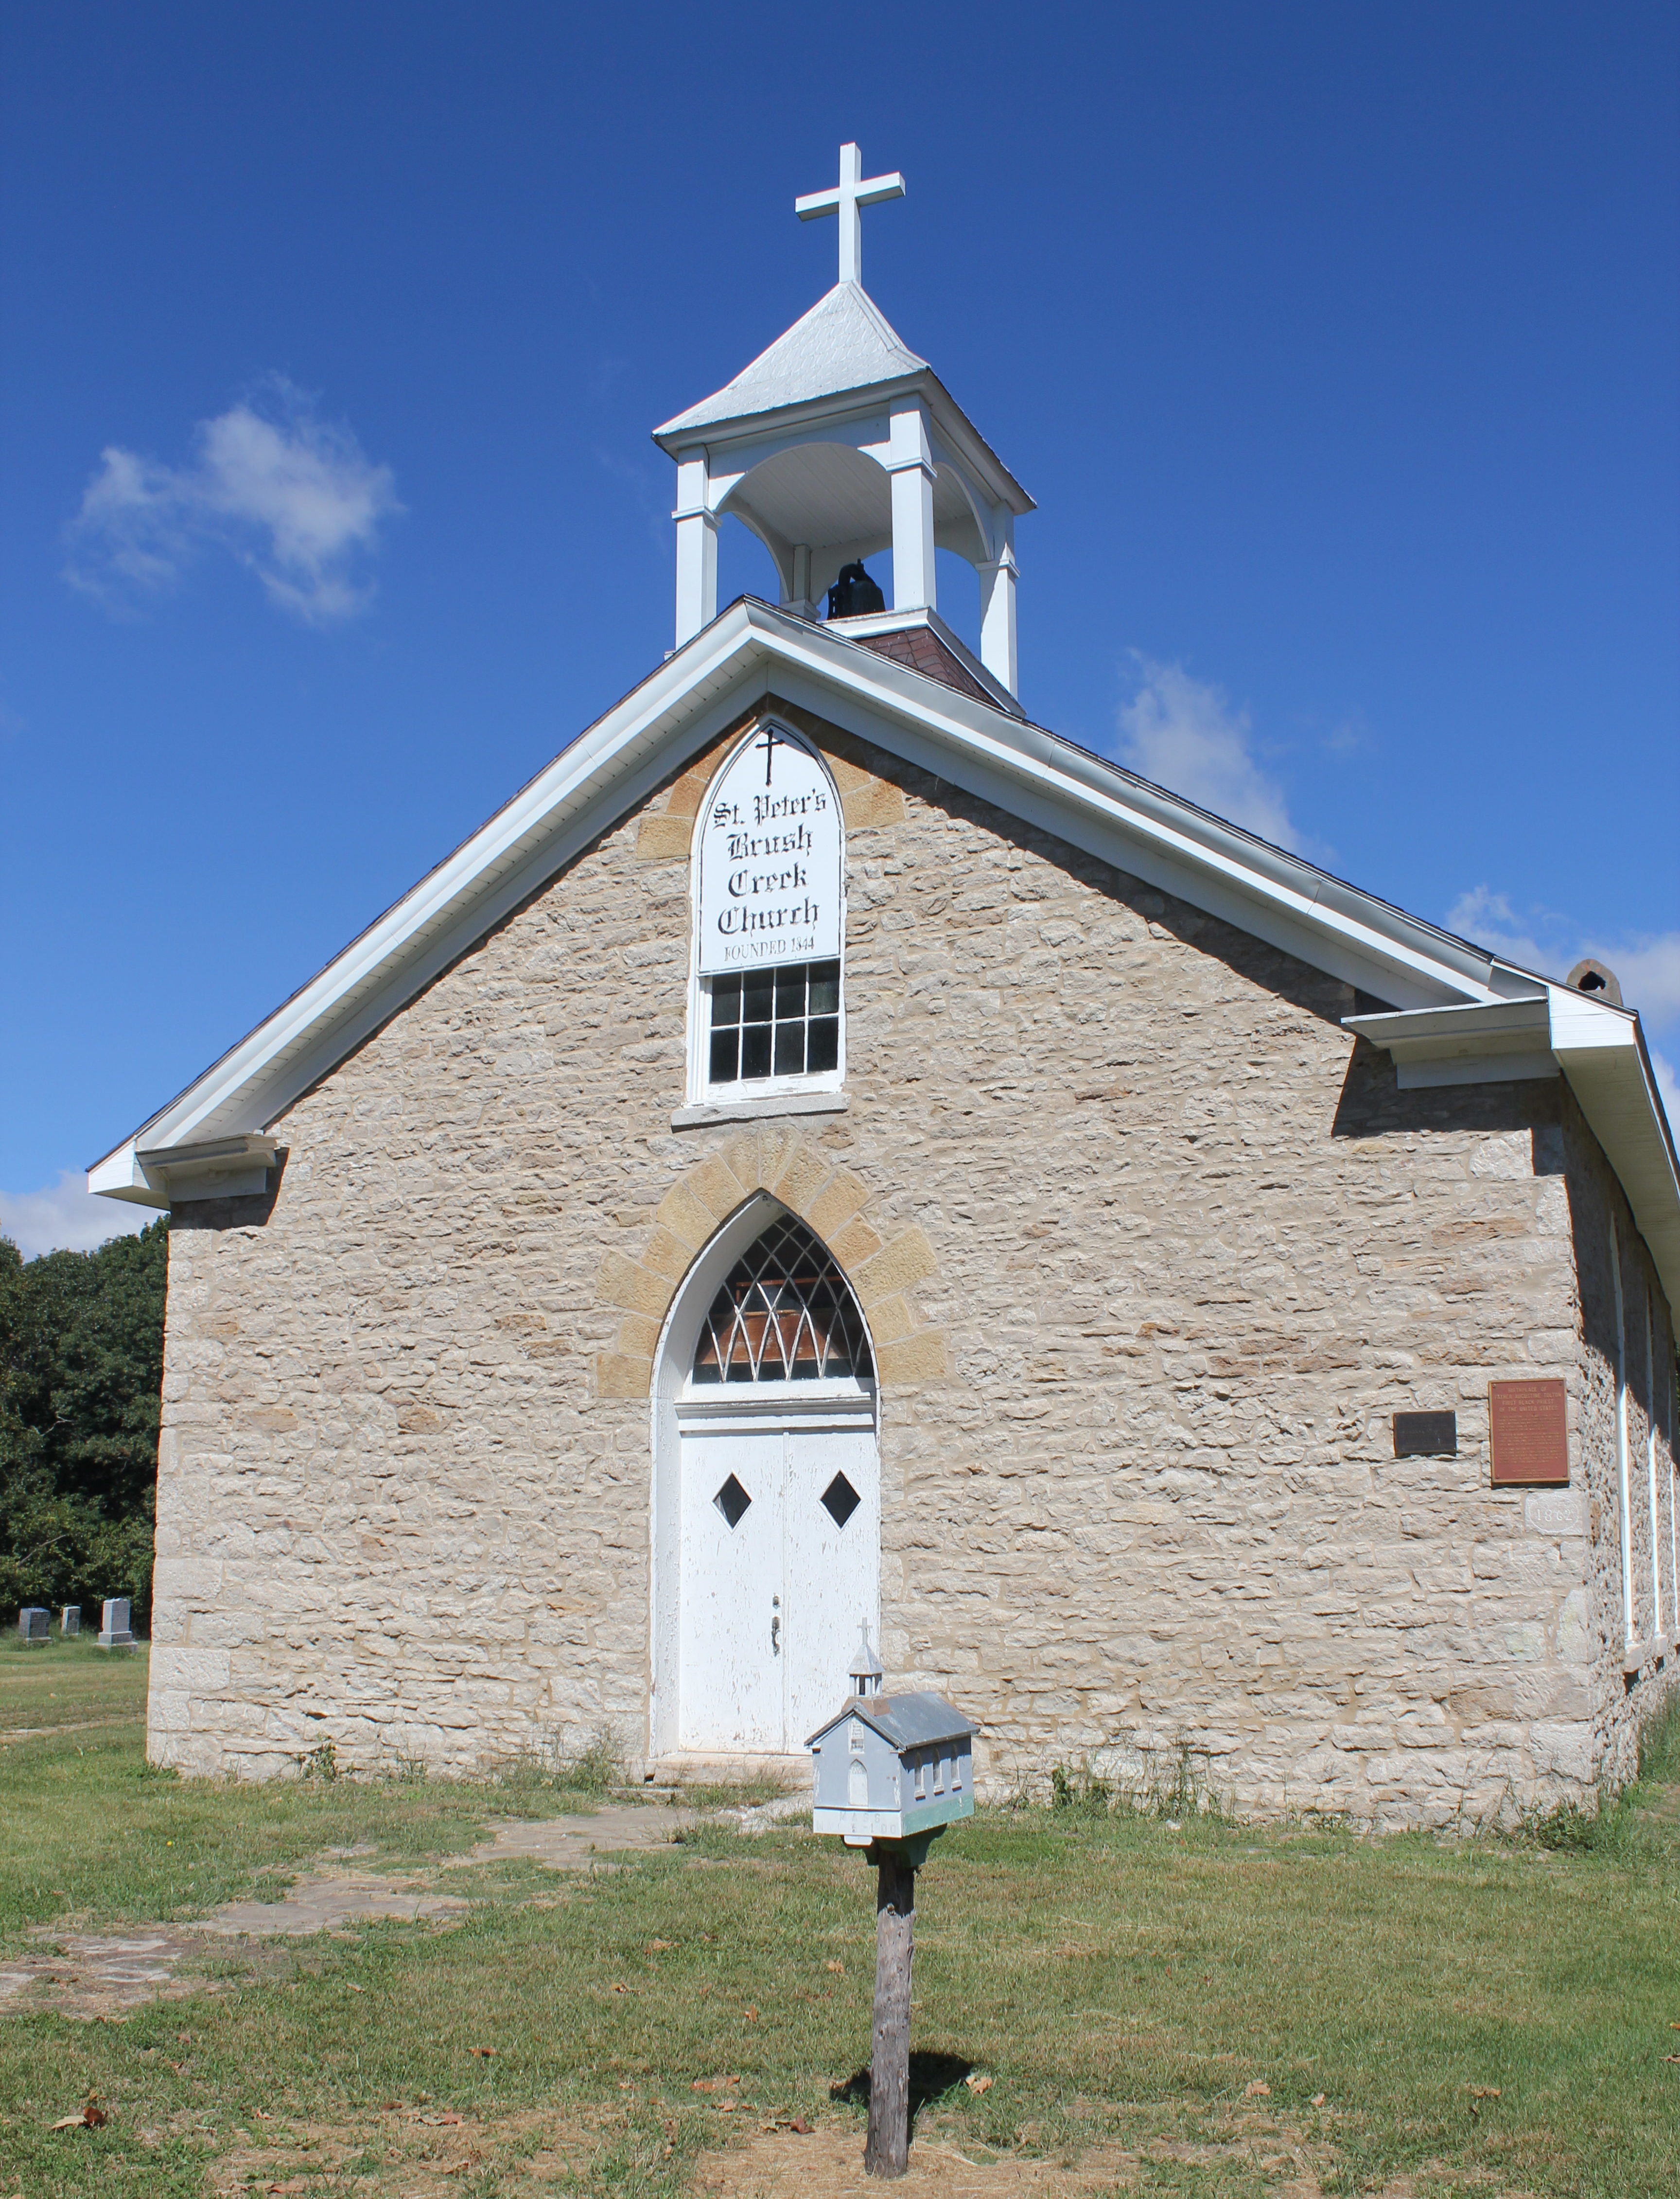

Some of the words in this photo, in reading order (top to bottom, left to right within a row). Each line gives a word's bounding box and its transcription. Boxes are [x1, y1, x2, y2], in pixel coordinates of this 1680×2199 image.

[712, 802, 746, 830] St.
[753, 788, 826, 827] Peter's
[726, 822, 813, 862] Brush
[728, 861, 809, 897] Creek
[718, 896, 820, 938] Church
[724, 939, 787, 962] FOUNDED
[791, 935, 815, 953] 1844
